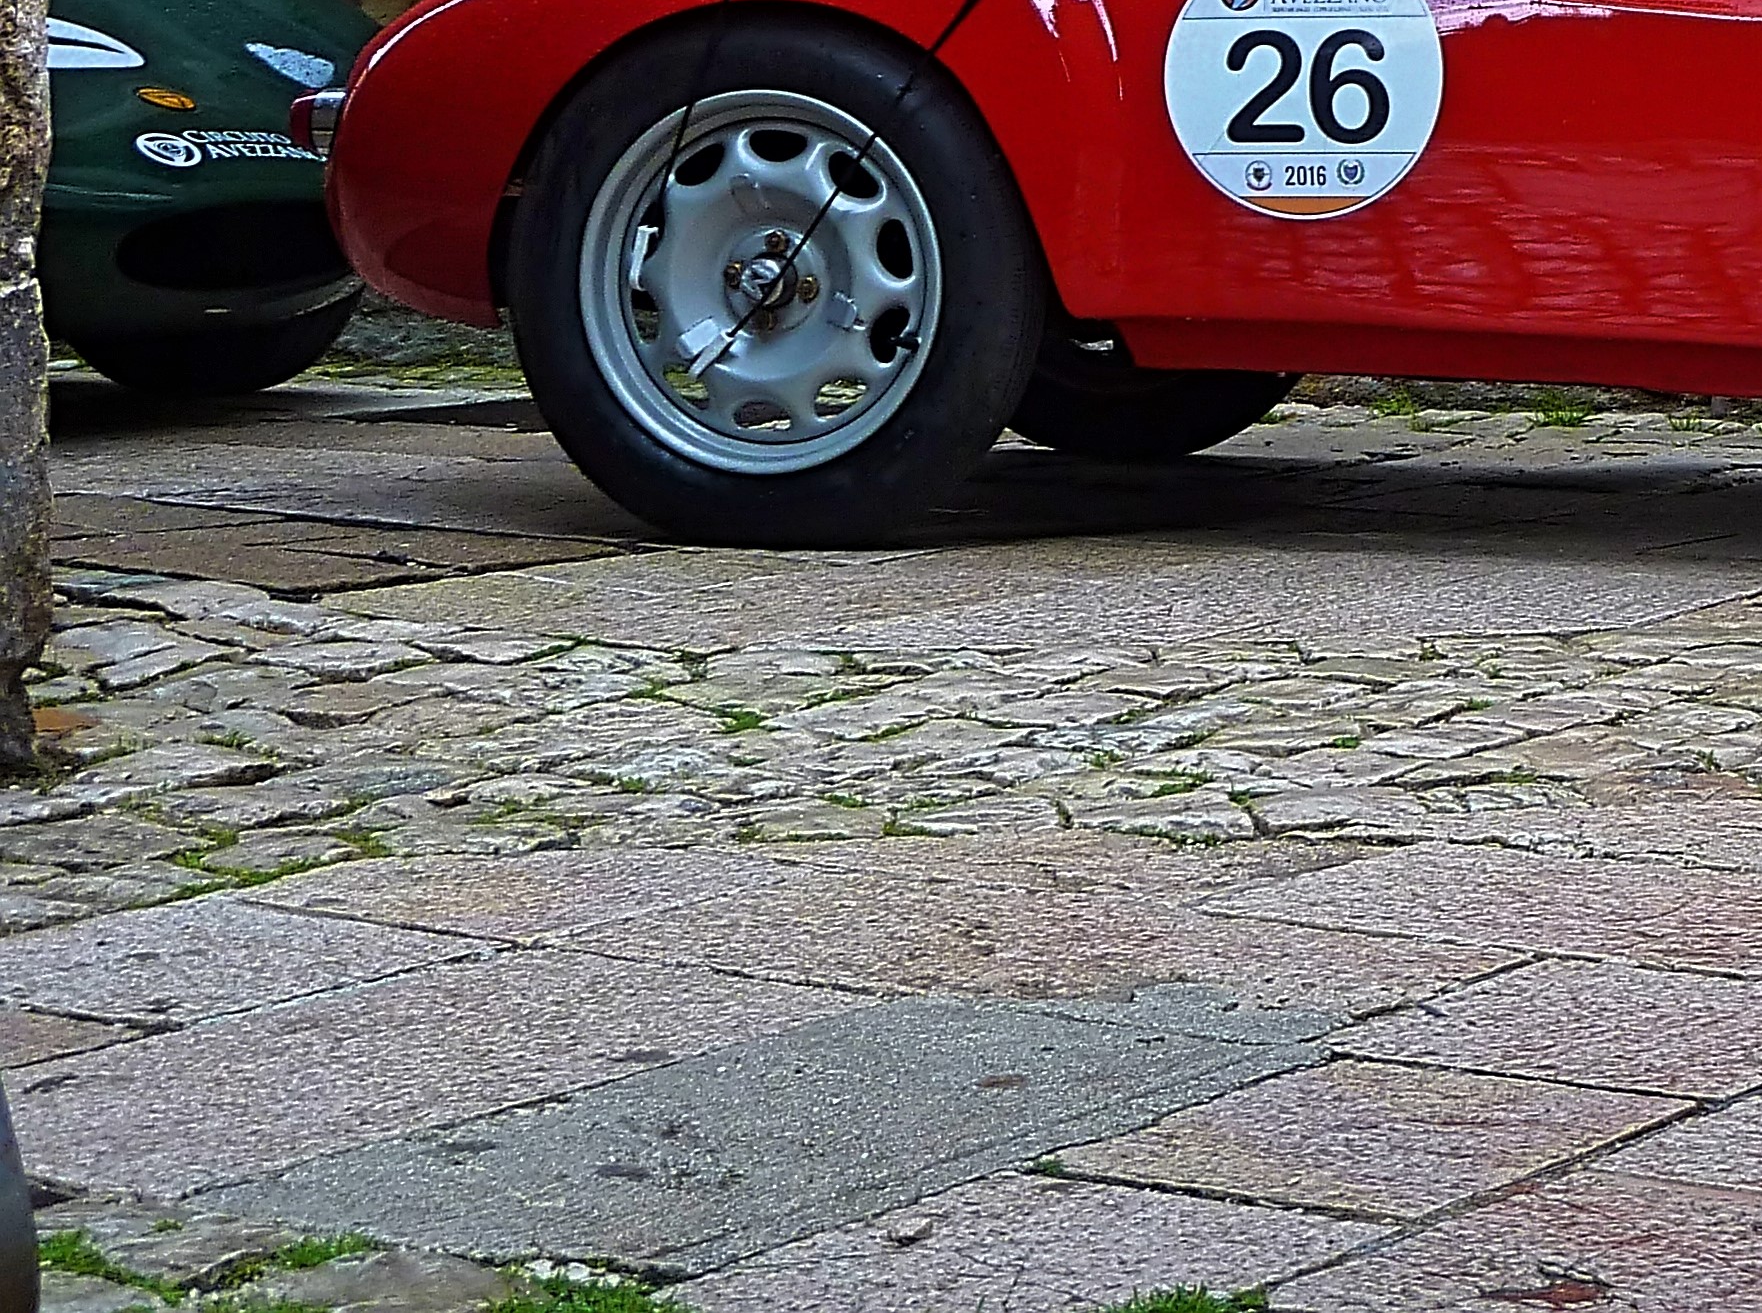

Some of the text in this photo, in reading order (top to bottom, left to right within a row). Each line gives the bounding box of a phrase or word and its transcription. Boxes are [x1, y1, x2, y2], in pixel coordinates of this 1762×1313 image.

[1226, 28, 1390, 144] 26
[182, 130, 292, 145] CIRCUITO
[1284, 165, 1327, 186] 2016
